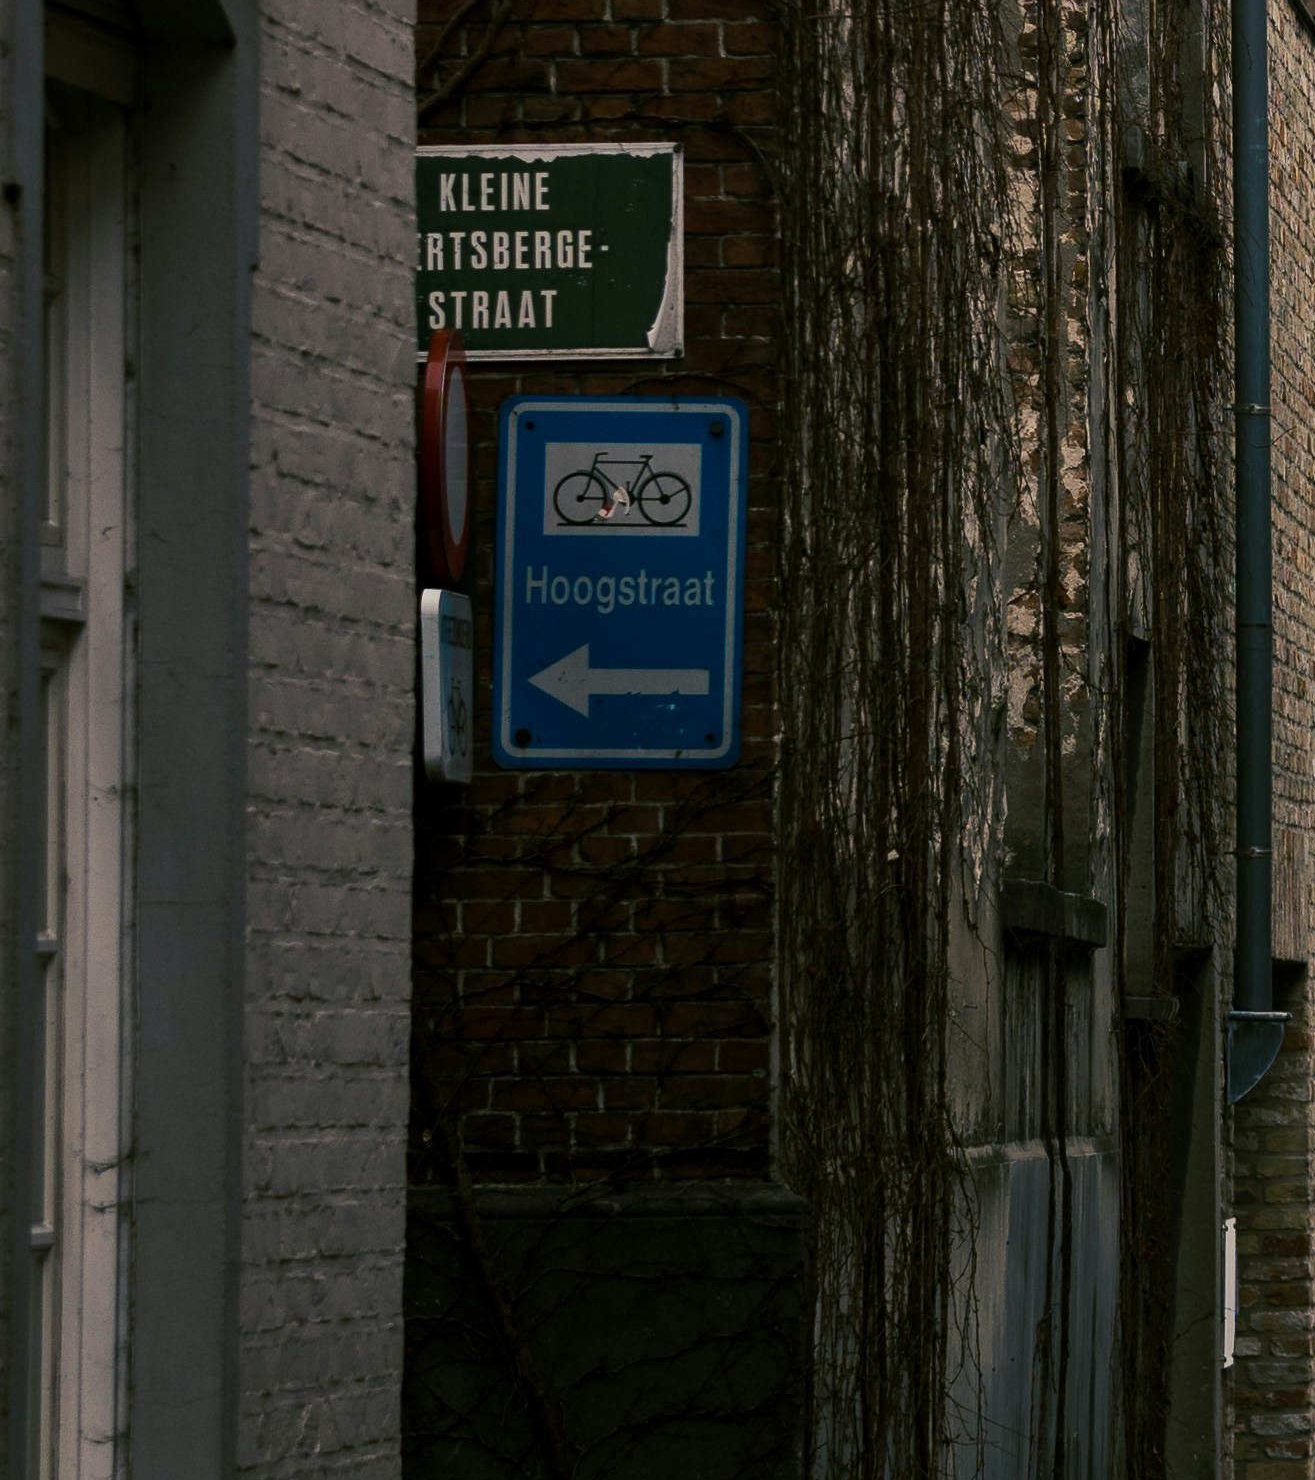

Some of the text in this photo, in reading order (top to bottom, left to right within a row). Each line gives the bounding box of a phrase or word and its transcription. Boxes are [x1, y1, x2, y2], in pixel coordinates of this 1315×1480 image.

[439, 171, 550, 212] KLEINE
[428, 288, 558, 330] STRAAT
[525, 565, 715, 614] Hoogstraat
